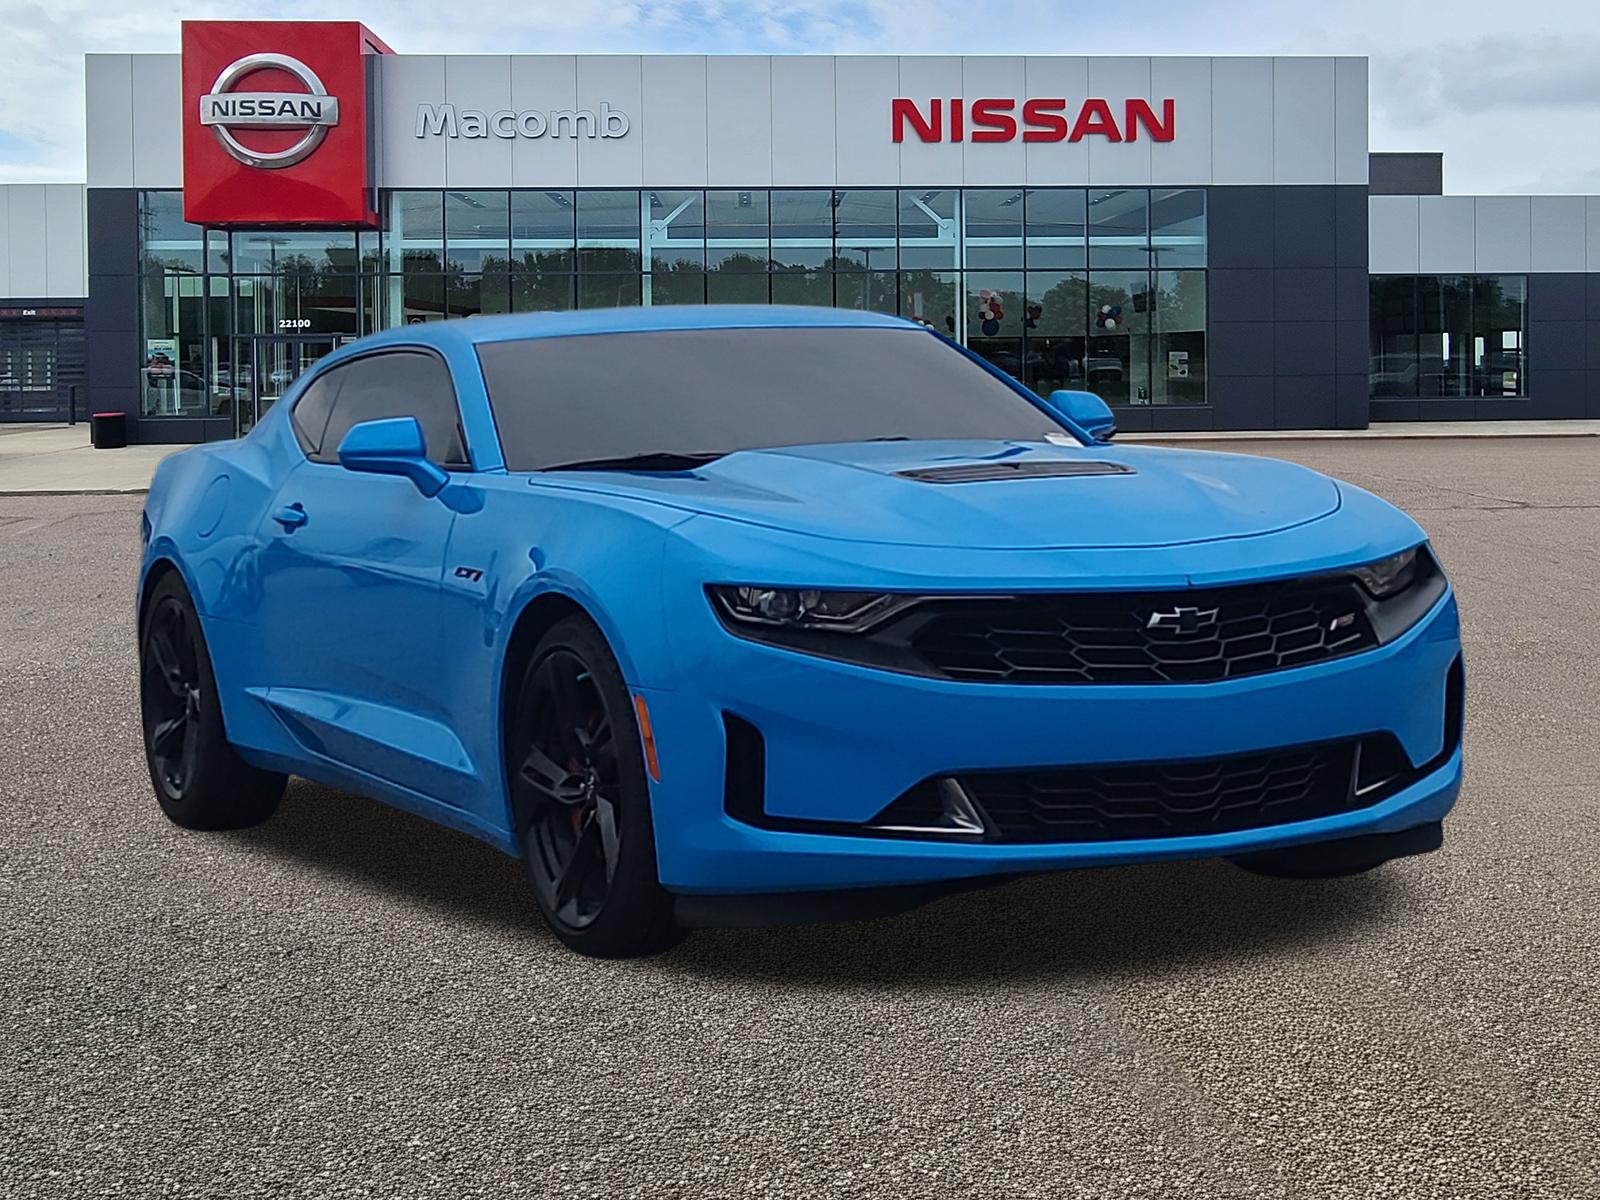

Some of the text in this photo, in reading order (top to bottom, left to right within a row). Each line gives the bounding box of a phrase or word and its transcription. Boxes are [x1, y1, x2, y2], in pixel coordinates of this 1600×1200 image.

[211, 100, 321, 117] NISSAN
[415, 102, 629, 138] Macomb
[892, 98, 1175, 143] NISSAN
[279, 319, 311, 328] 22100
